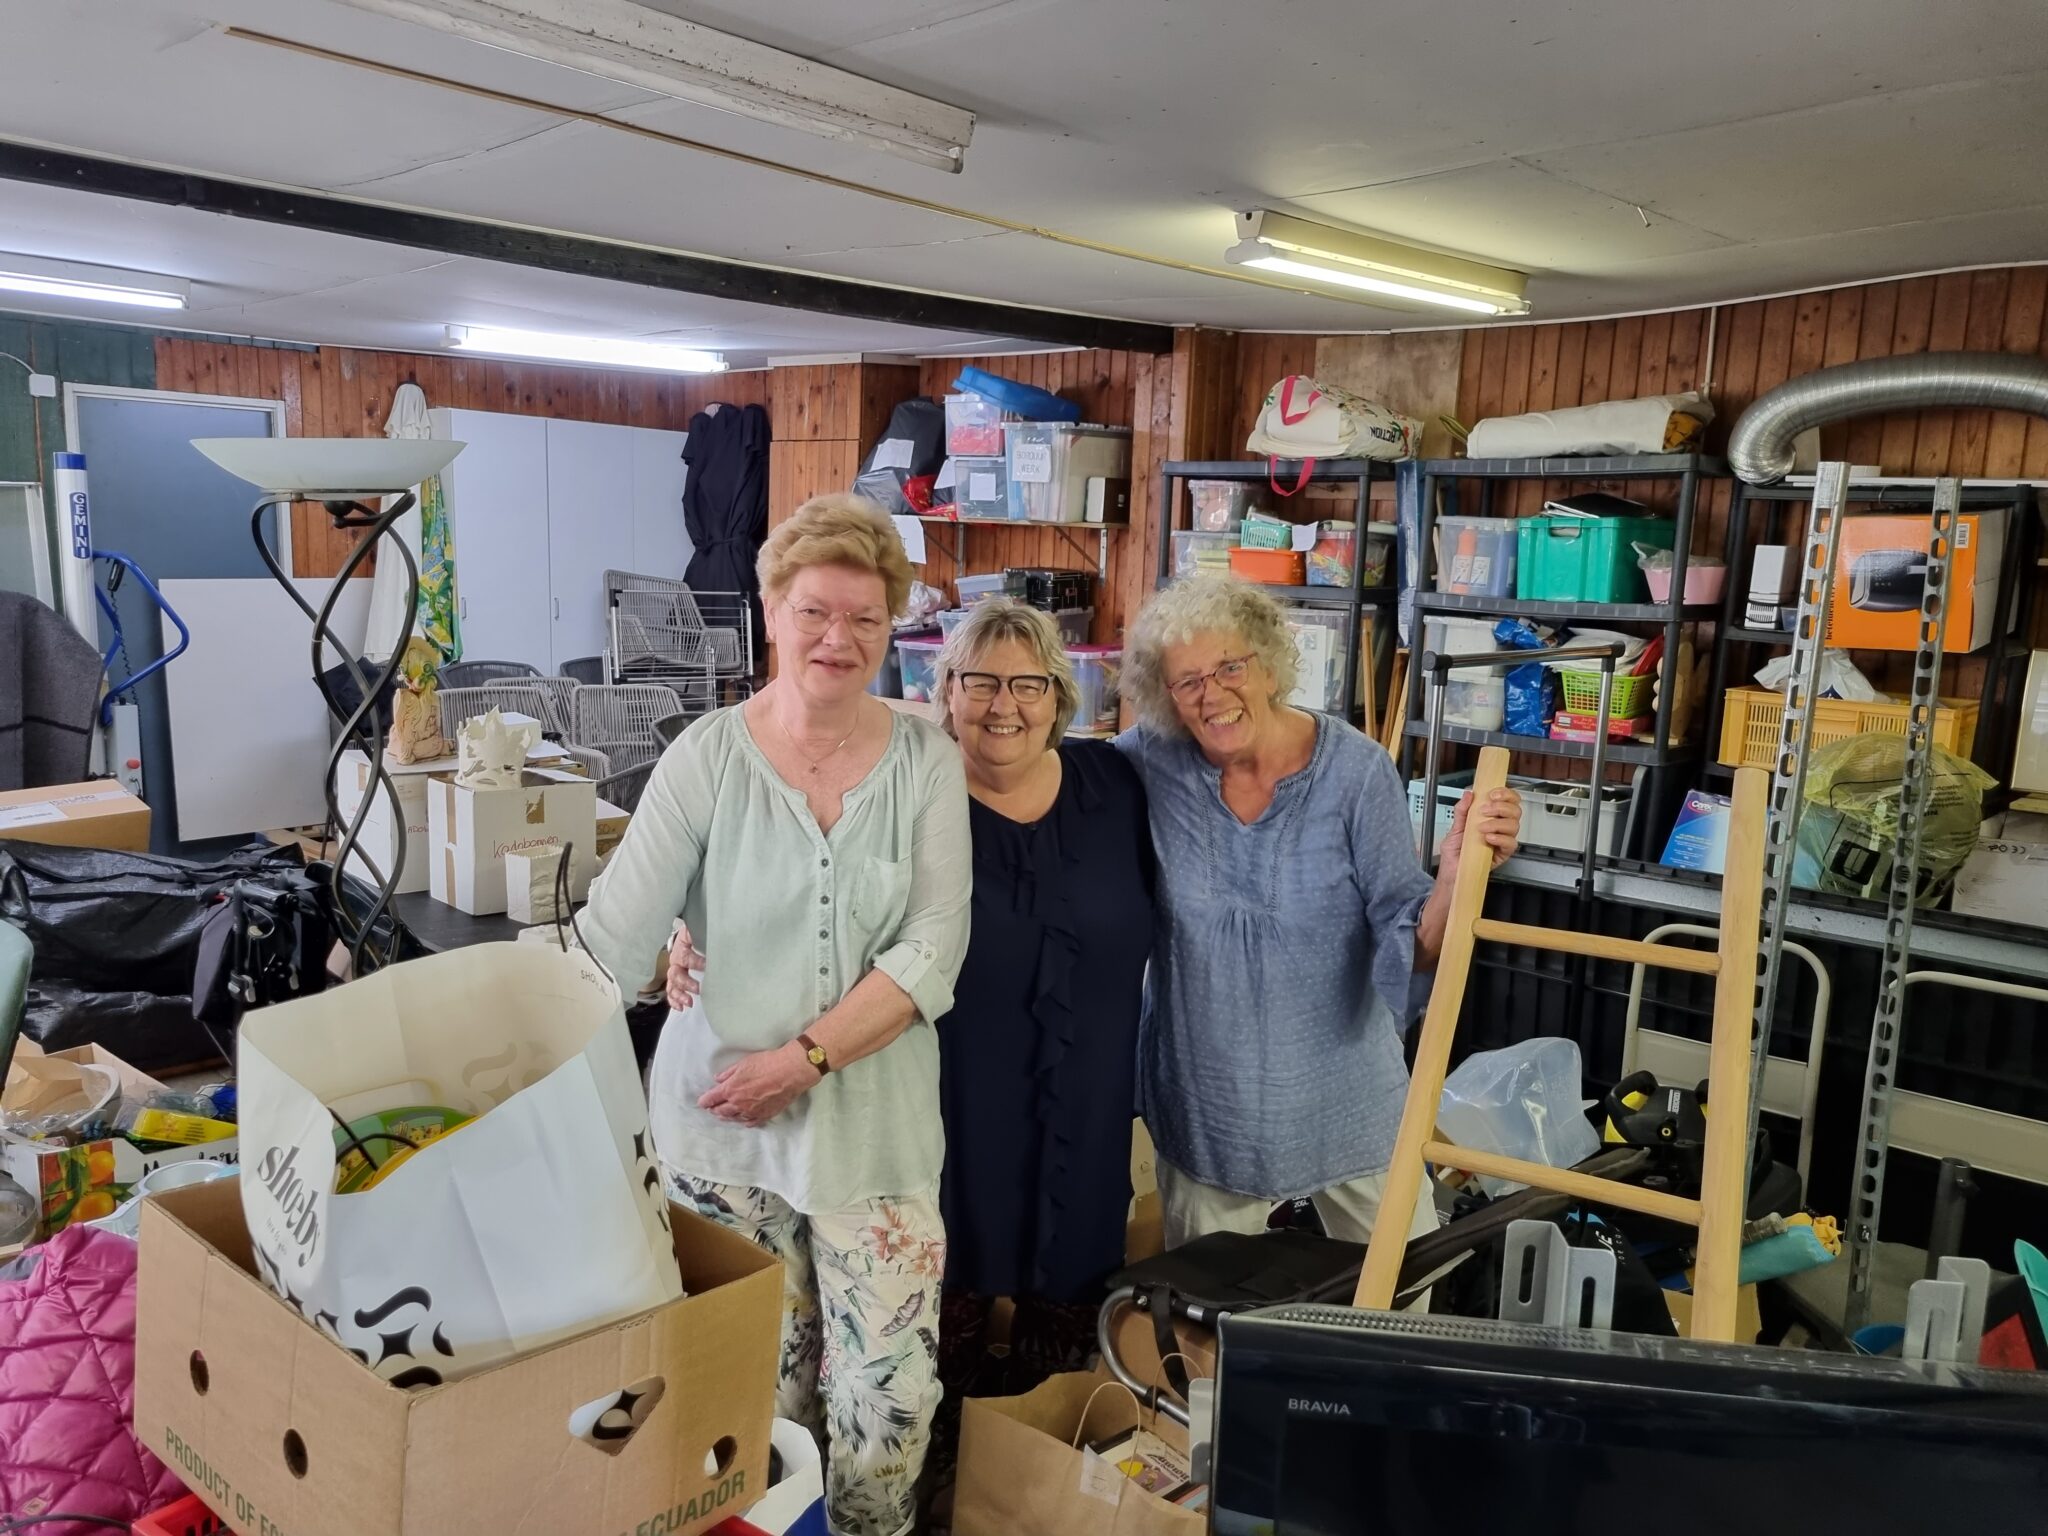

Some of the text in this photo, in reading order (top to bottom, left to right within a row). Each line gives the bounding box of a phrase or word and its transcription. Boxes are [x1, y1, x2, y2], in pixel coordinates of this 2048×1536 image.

[1369, 426, 1396, 443] ACTION
[72, 493, 88, 558] GEMINI
[1288, 1398, 1351, 1415] BRAVIA
[166, 1426, 231, 1507] PRODUCT
[236, 1492, 255, 1527] OF
[636, 1469, 746, 1536] ECUADOR
